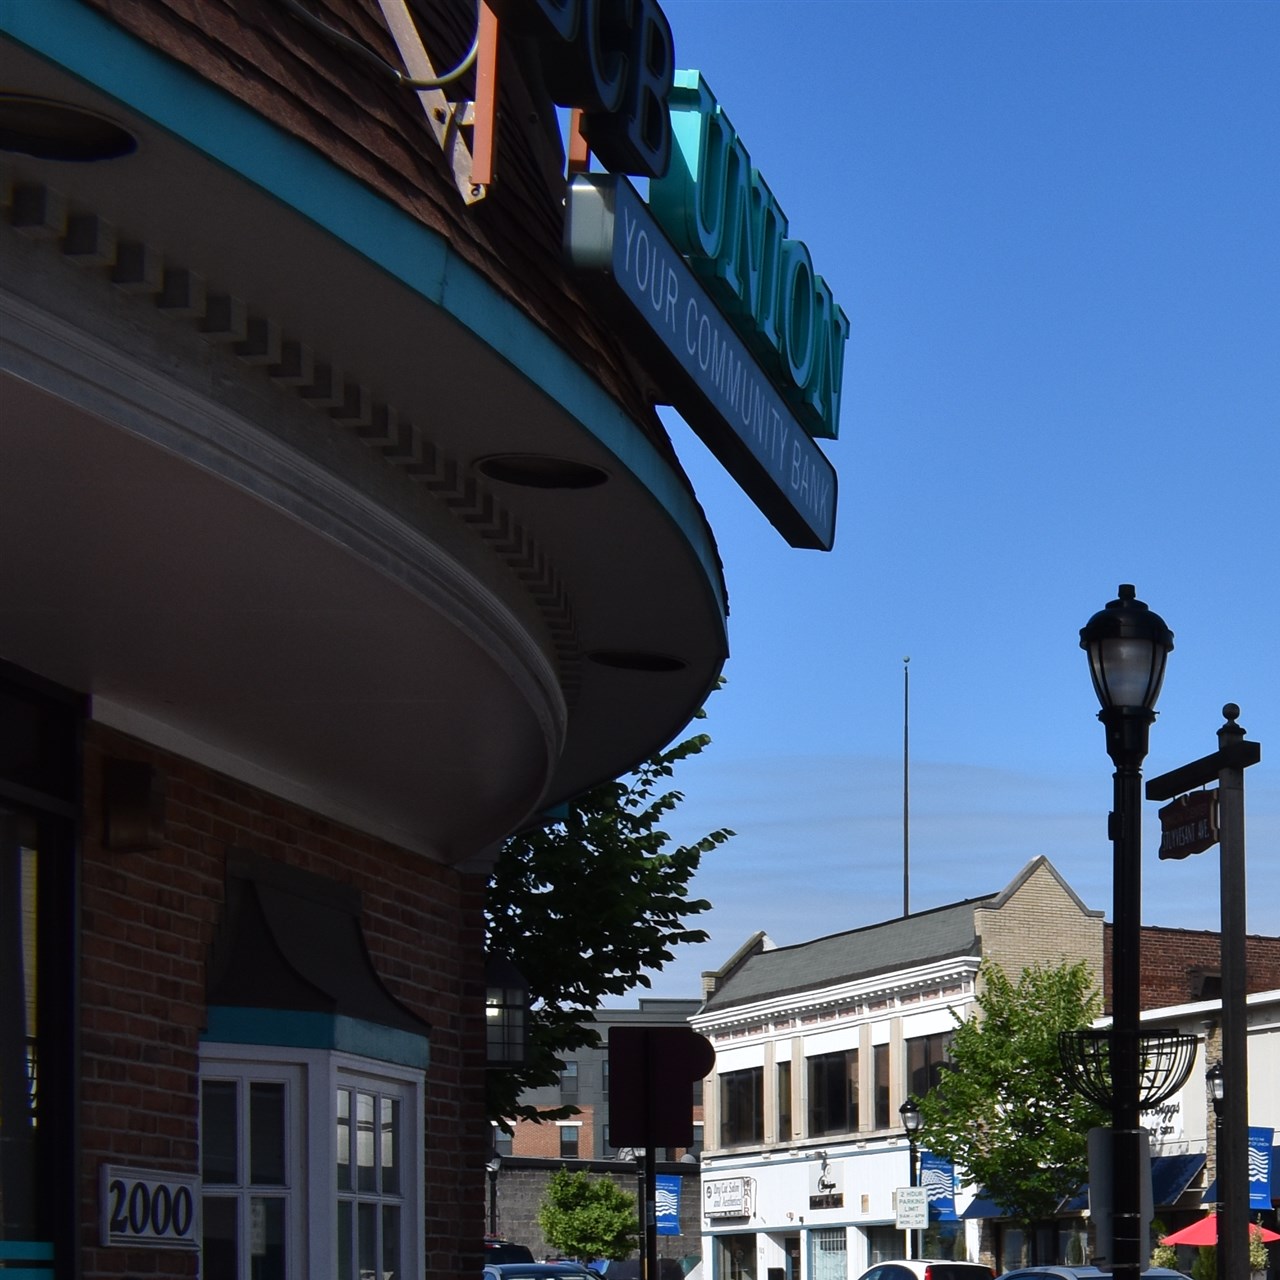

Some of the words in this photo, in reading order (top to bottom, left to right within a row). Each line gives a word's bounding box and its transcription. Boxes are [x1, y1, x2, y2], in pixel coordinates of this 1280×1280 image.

[624, 206, 678, 333] YOUR
[686, 298, 788, 471] COMMUNITY
[791, 448, 829, 528] BANK
[680, 70, 850, 440] UNION
[109, 1179, 193, 1237] 2000
